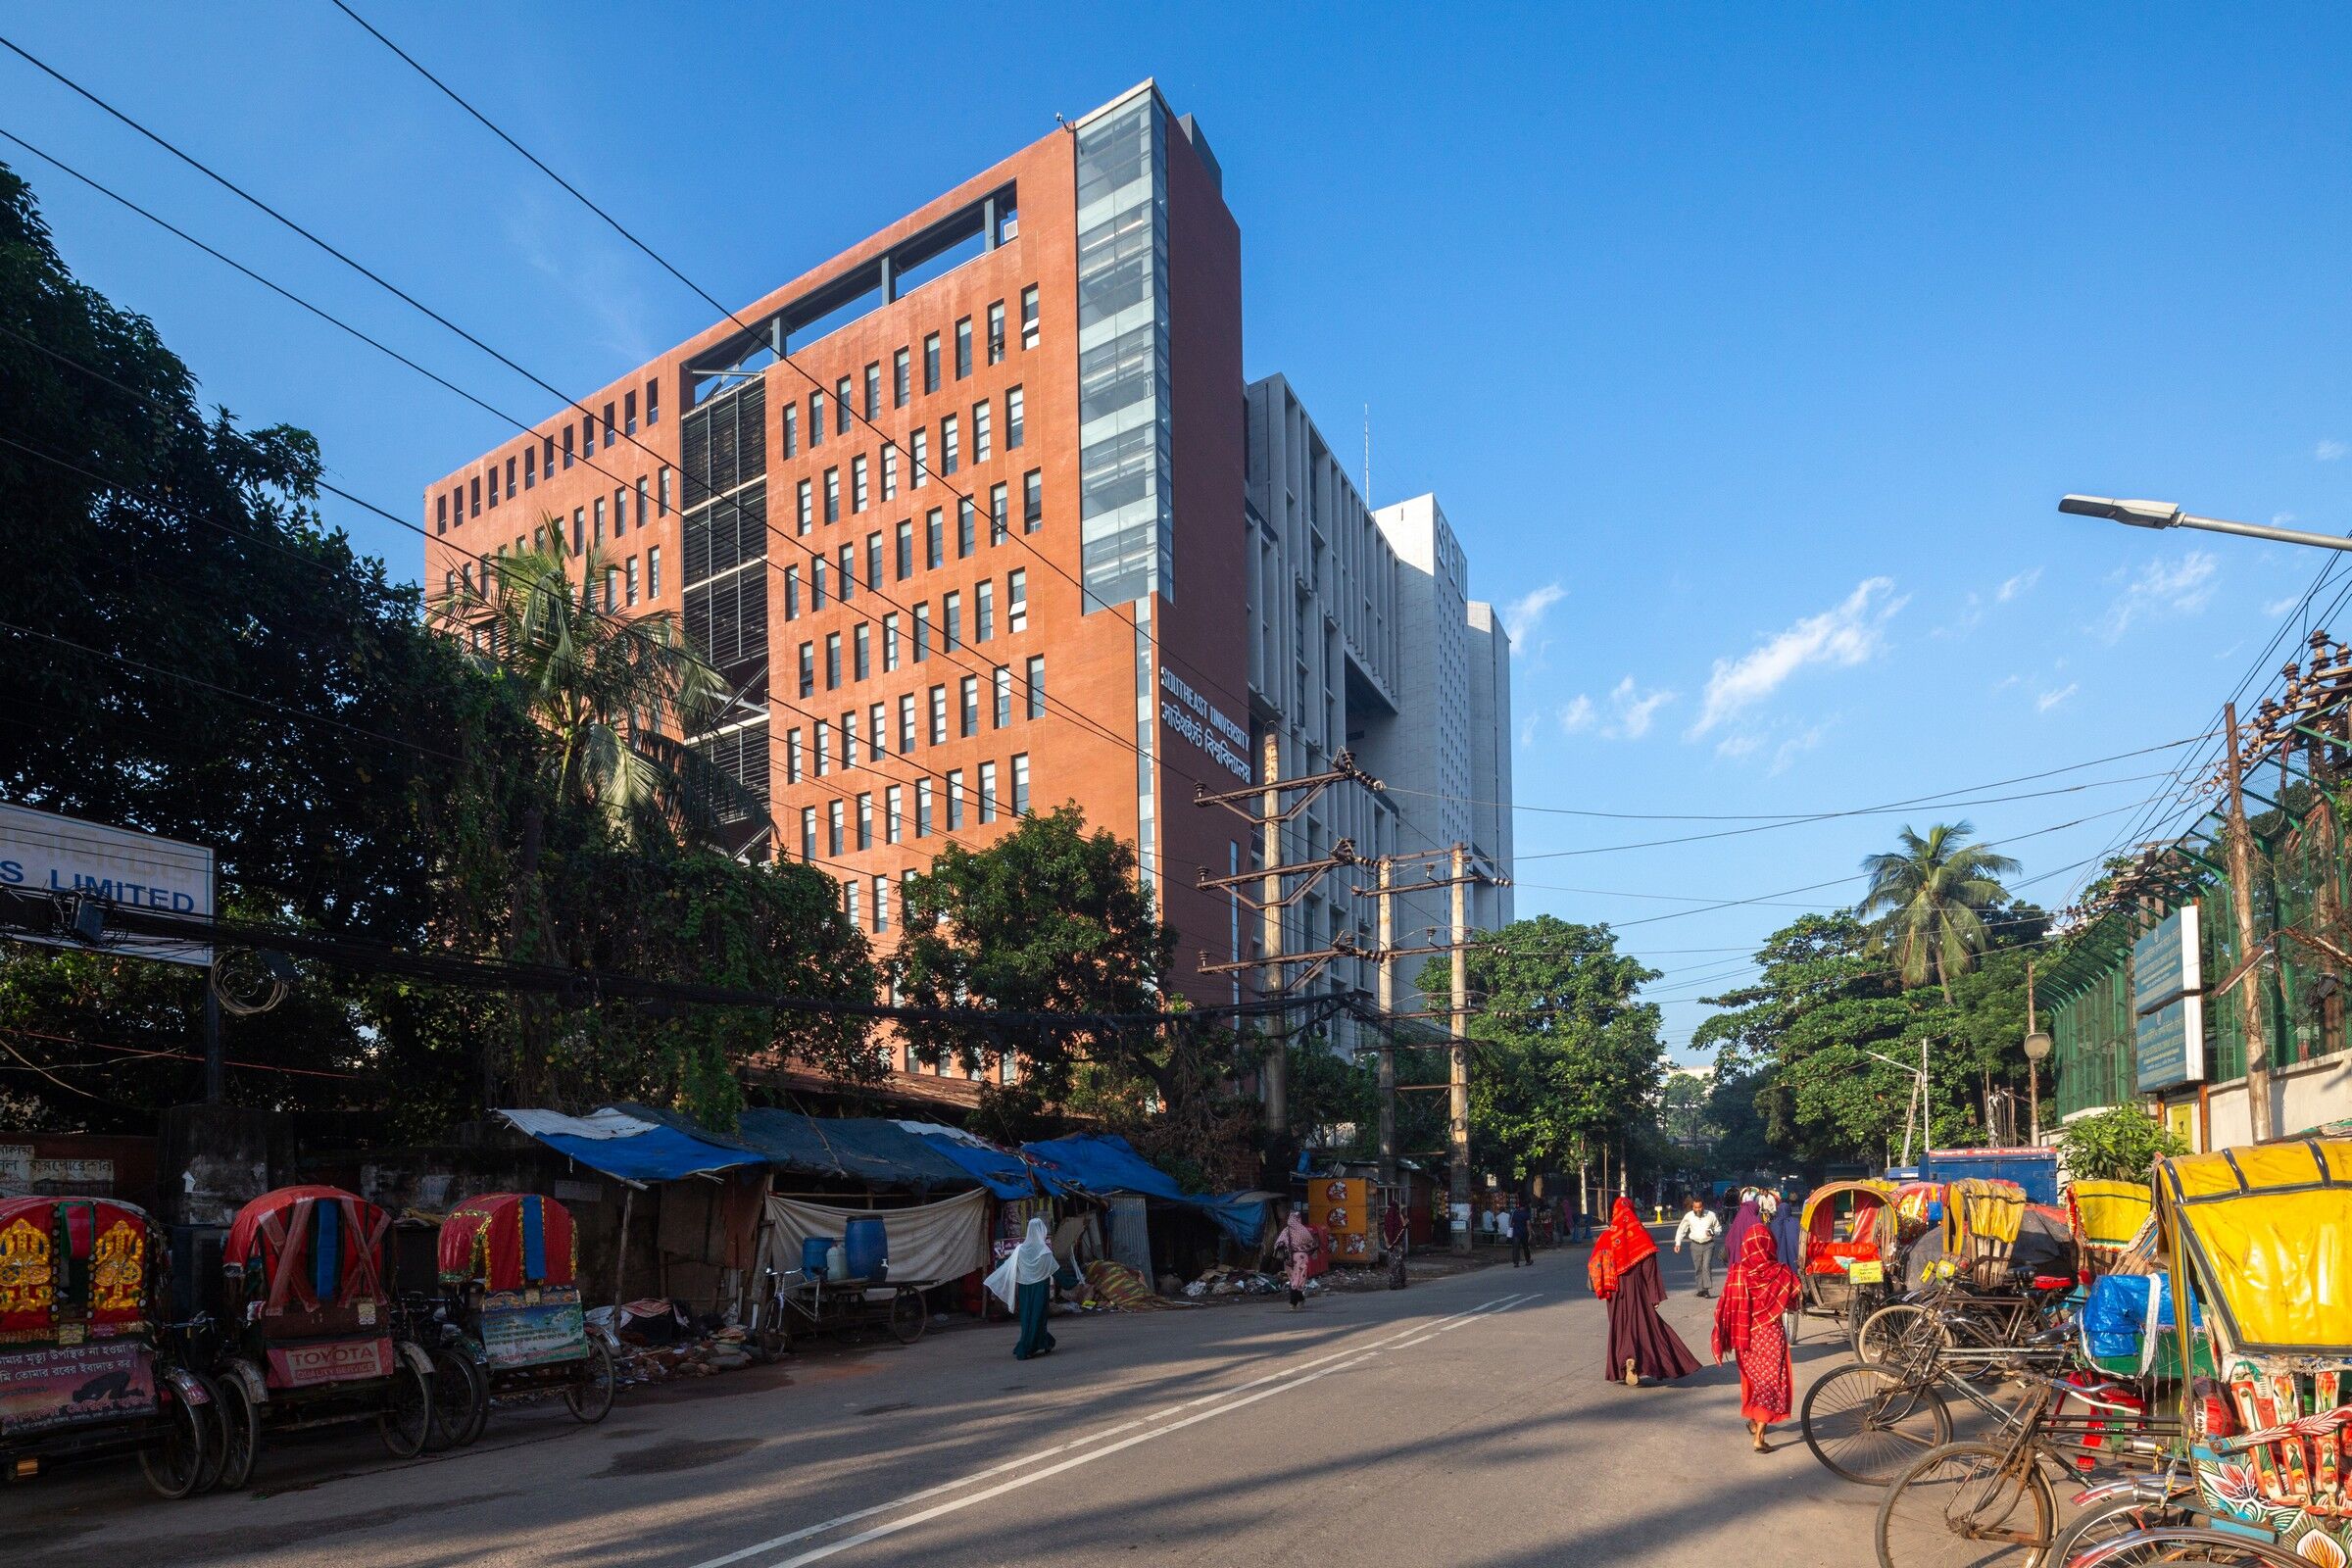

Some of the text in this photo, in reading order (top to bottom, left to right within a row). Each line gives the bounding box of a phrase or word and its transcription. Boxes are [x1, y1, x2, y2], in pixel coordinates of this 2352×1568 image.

[1161, 666, 1250, 752] SOUTHEAST UNIVERSITY
[51, 869, 194, 912] LIMITED
[87, 1347, 99, 1356] না
[292, 1347, 373, 1365] TOYOTA
[15, 1369, 48, 1380] তোমার
[51, 1366, 76, 1376] রবের
[296, 1363, 376, 1379] QUALITY SERVICE
